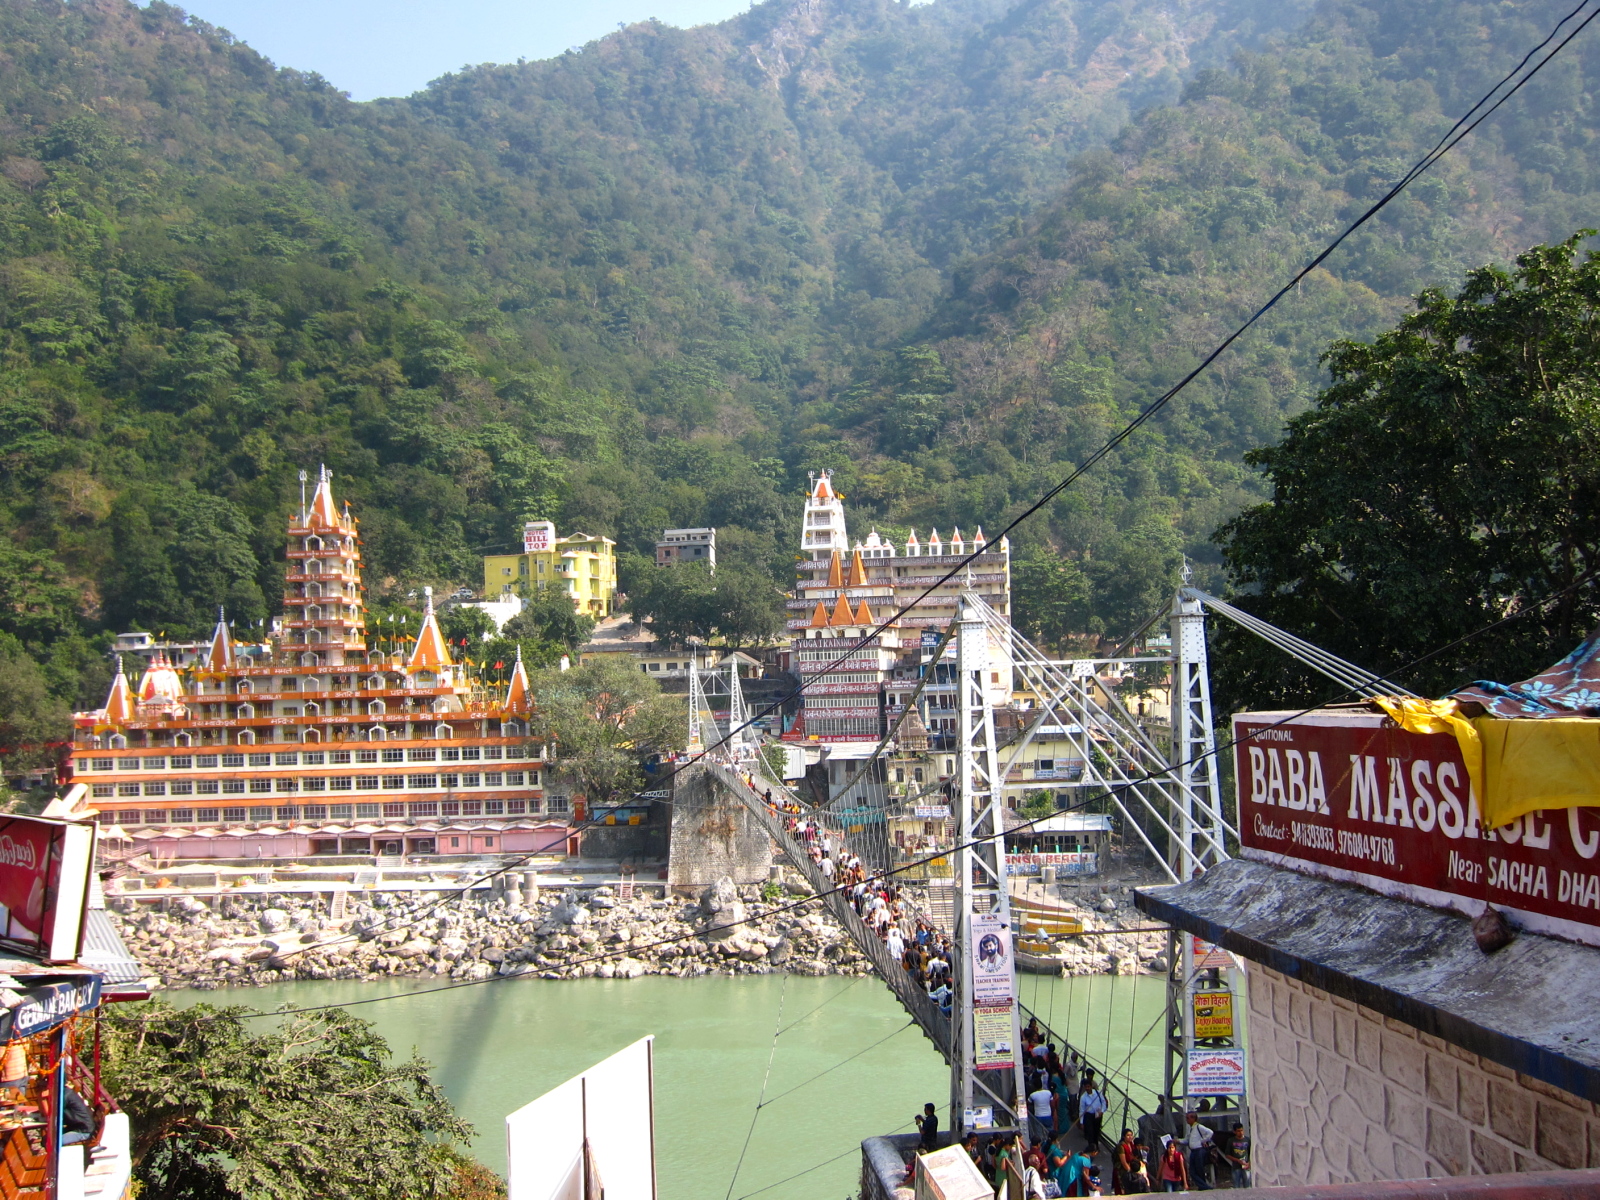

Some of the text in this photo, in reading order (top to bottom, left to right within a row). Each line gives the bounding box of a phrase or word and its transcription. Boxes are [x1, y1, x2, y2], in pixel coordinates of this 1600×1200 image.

[798, 638, 818, 648] YOGA
[819, 638, 852, 648] TRAINING
[1248, 728, 1294, 742] TRADITIONAL
[1249, 746, 1330, 816] BABA
[1046, 854, 1088, 864] BEACH
[1448, 850, 1600, 910] Near SACHA DHA
[1211, 994, 1229, 1007] विहार
[18, 996, 56, 1029] GERMAN
[1196, 1016, 1232, 1026] Enjoy Boating
